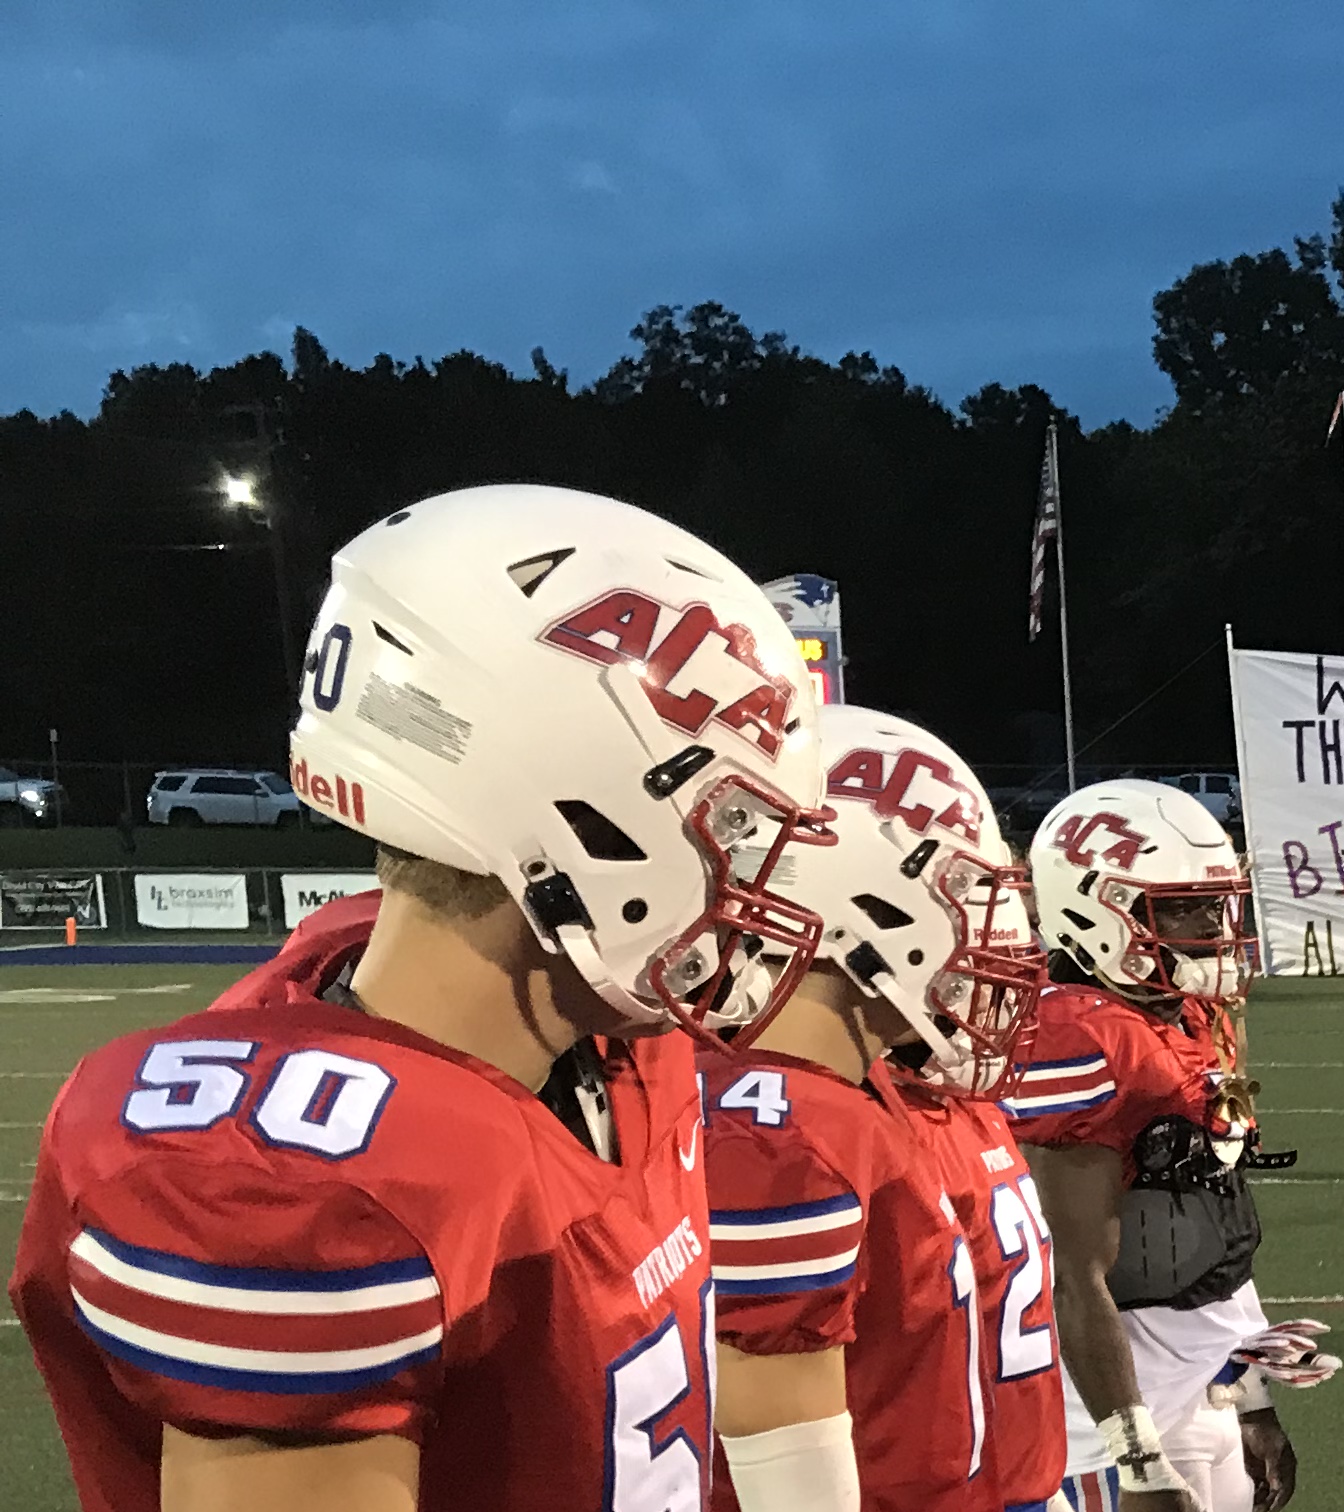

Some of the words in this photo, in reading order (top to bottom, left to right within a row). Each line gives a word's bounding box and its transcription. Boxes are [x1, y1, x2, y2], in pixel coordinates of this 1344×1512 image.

[536, 588, 797, 762] ACA
[290, 759, 366, 826] dell
[1048, 811, 1151, 873] ACA
[973, 927, 1019, 941] Rddell
[120, 1038, 398, 1163] 50
[696, 1068, 792, 1129] 4
[631, 1213, 703, 1311] PATRIOTS
